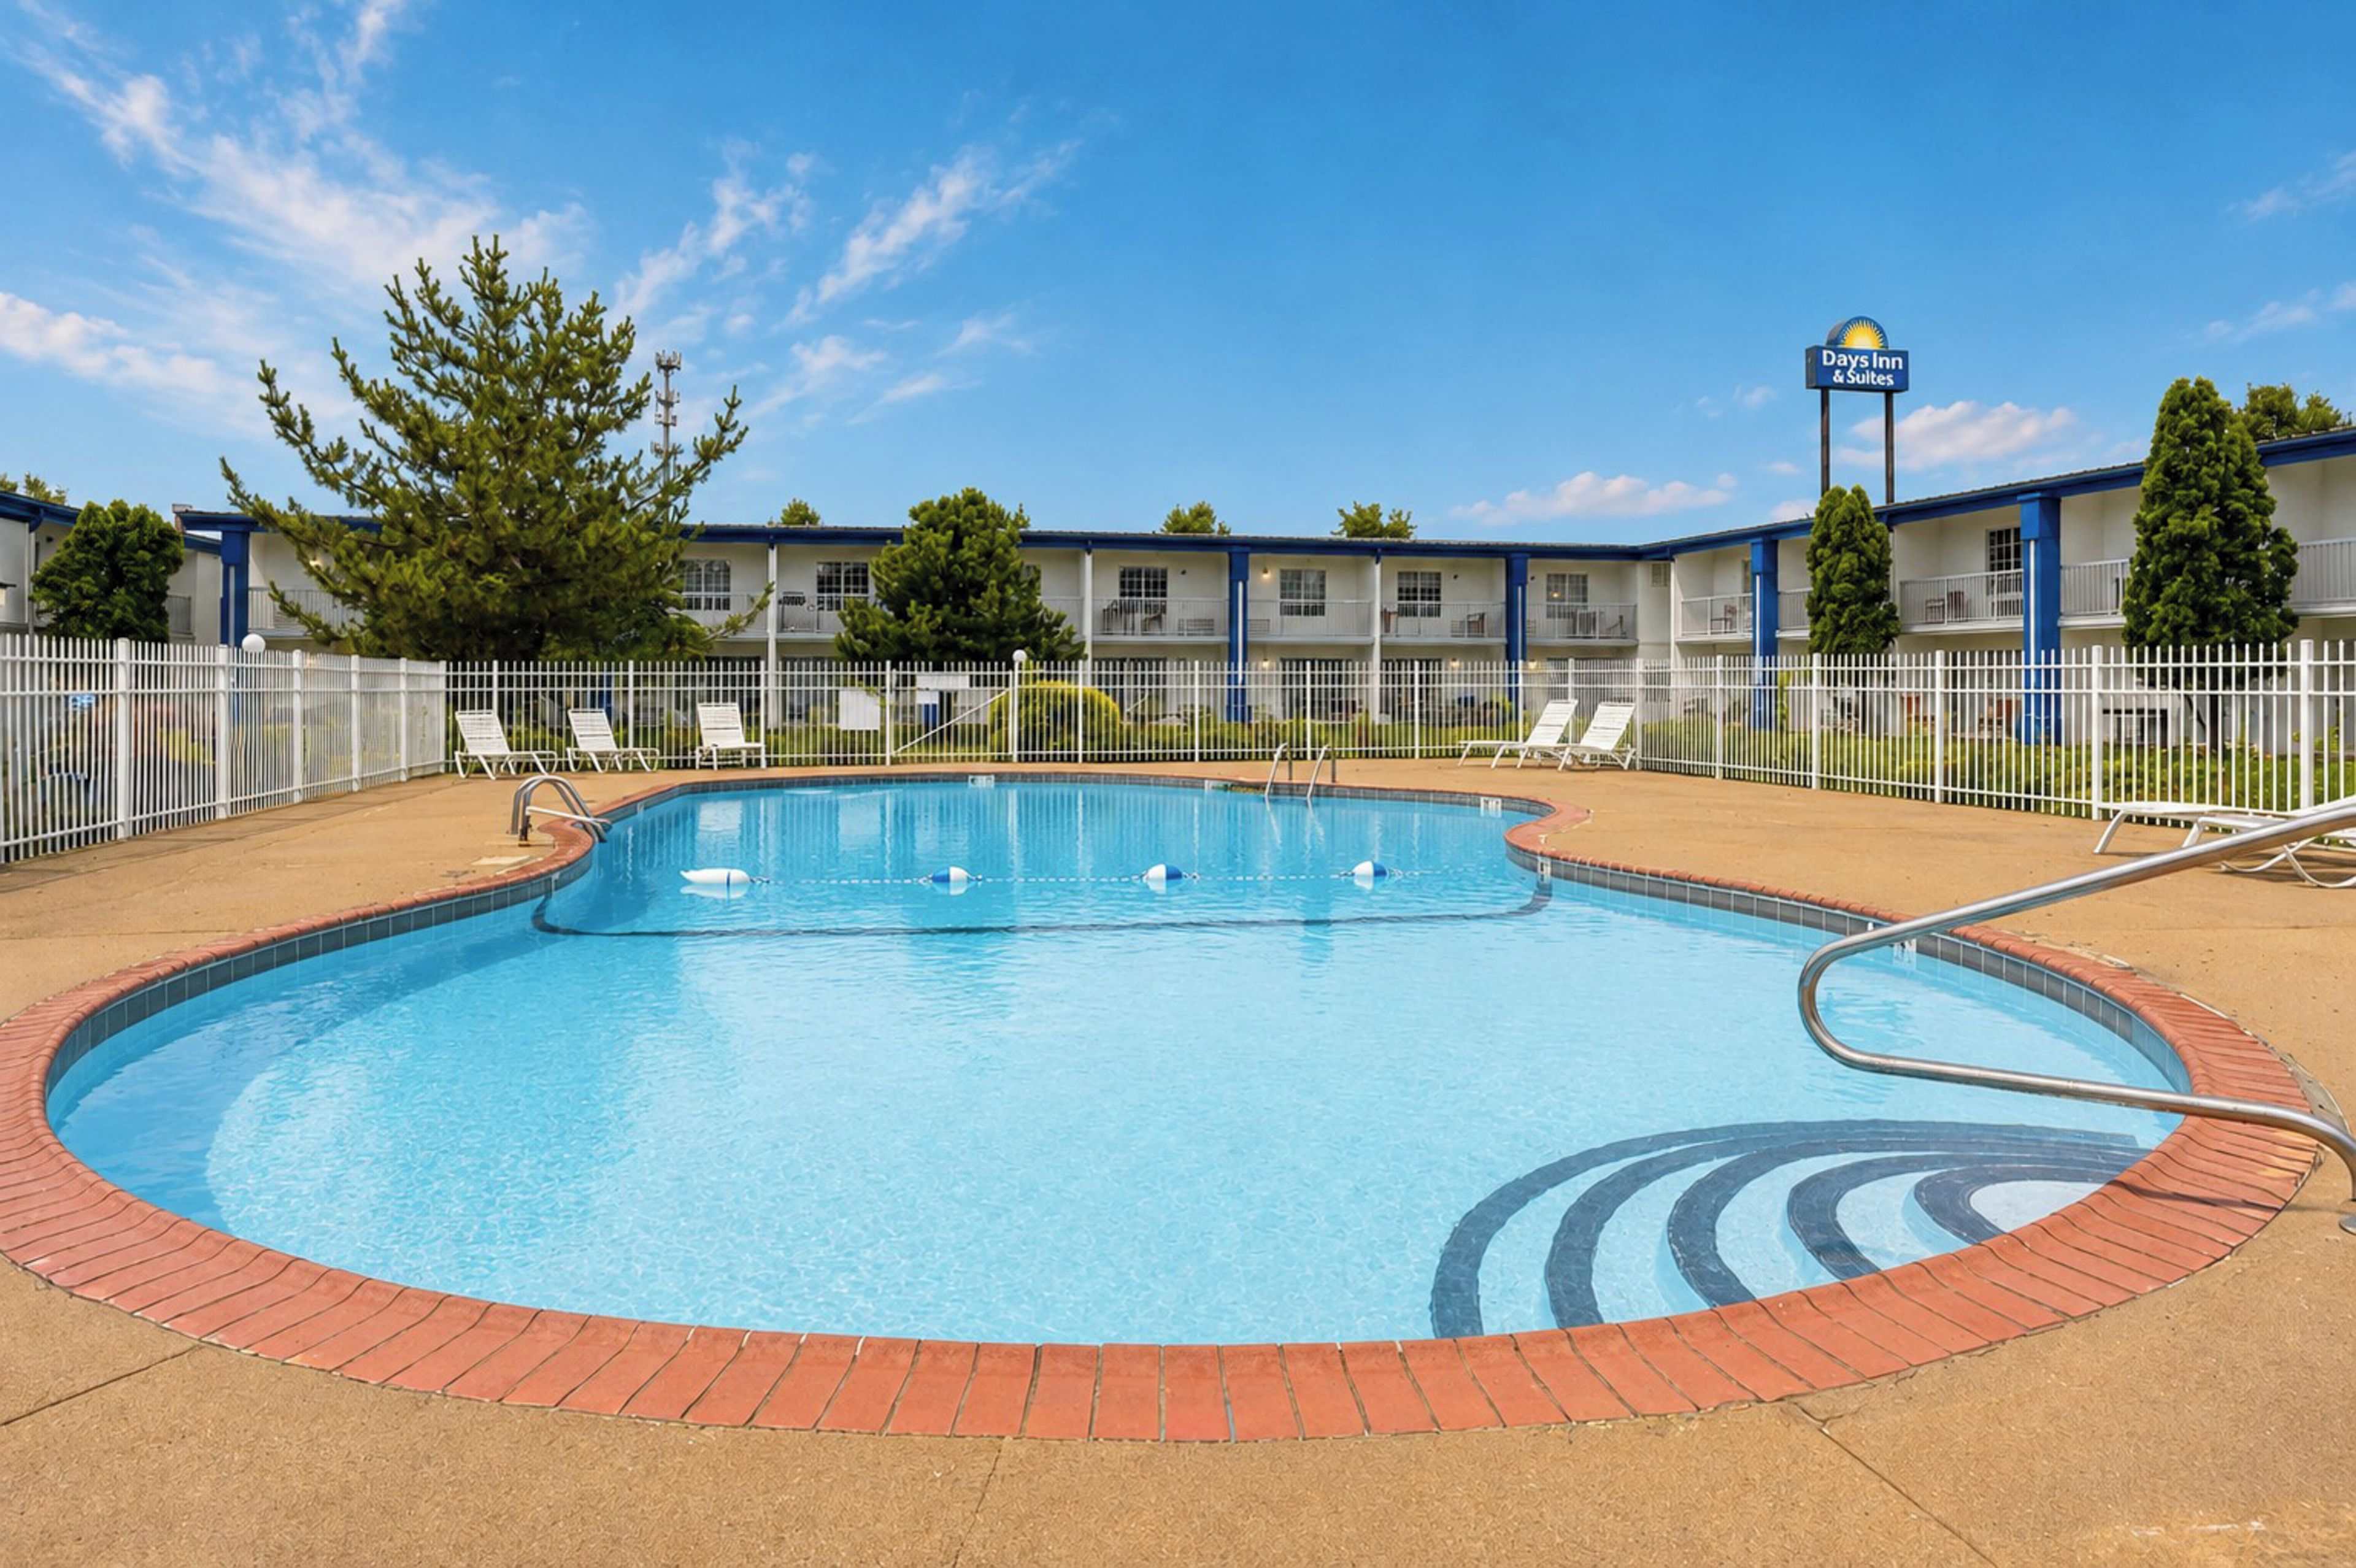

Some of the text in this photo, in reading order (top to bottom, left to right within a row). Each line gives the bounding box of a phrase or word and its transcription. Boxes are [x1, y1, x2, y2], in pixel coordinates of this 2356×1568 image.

[1822, 350, 1903, 371] Days Inn
[1833, 369, 1894, 386] & Suites
